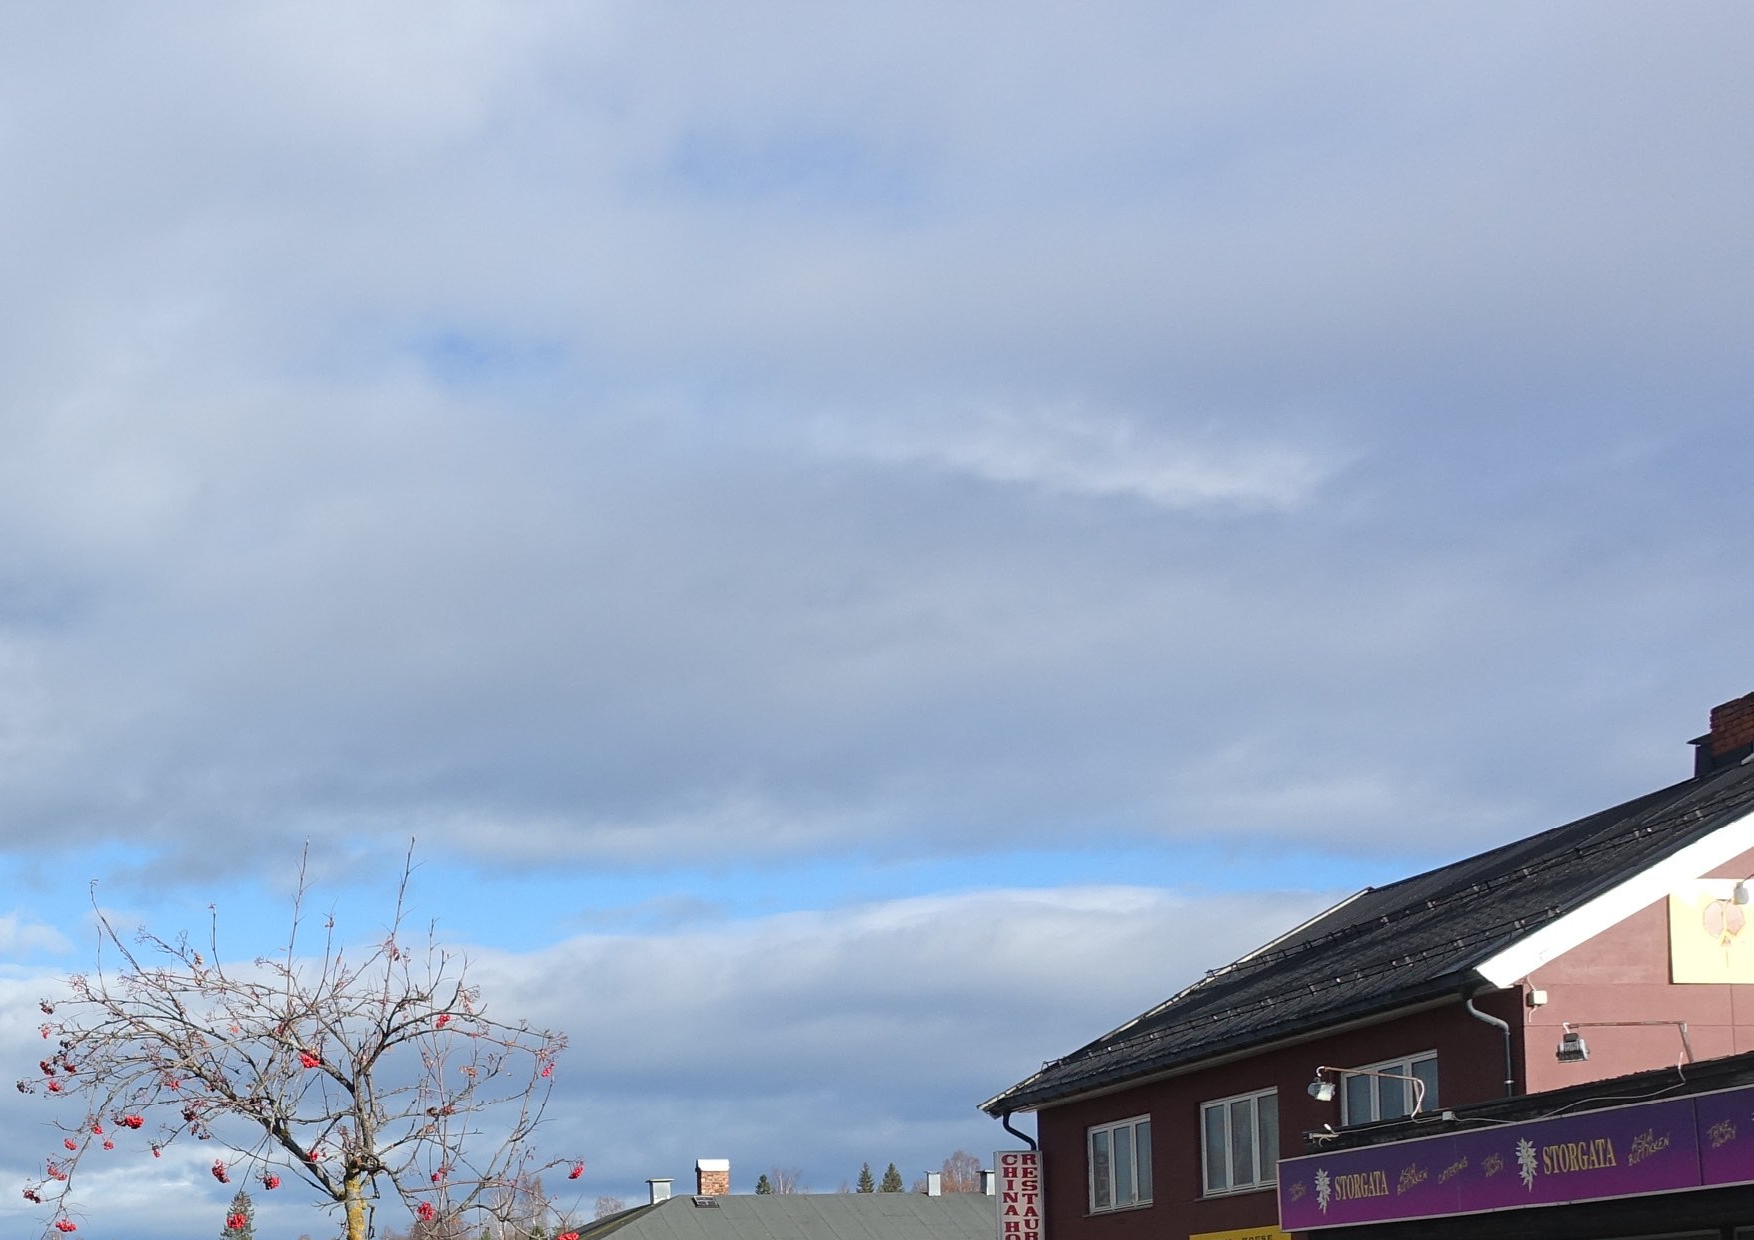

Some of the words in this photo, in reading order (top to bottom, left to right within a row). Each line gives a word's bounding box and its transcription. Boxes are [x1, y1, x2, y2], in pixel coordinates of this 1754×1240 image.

[1542, 1136, 1617, 1175] STORGATA
[1001, 1154, 1019, 1216] CHINA
[1334, 1170, 1389, 1200] STORGATA
